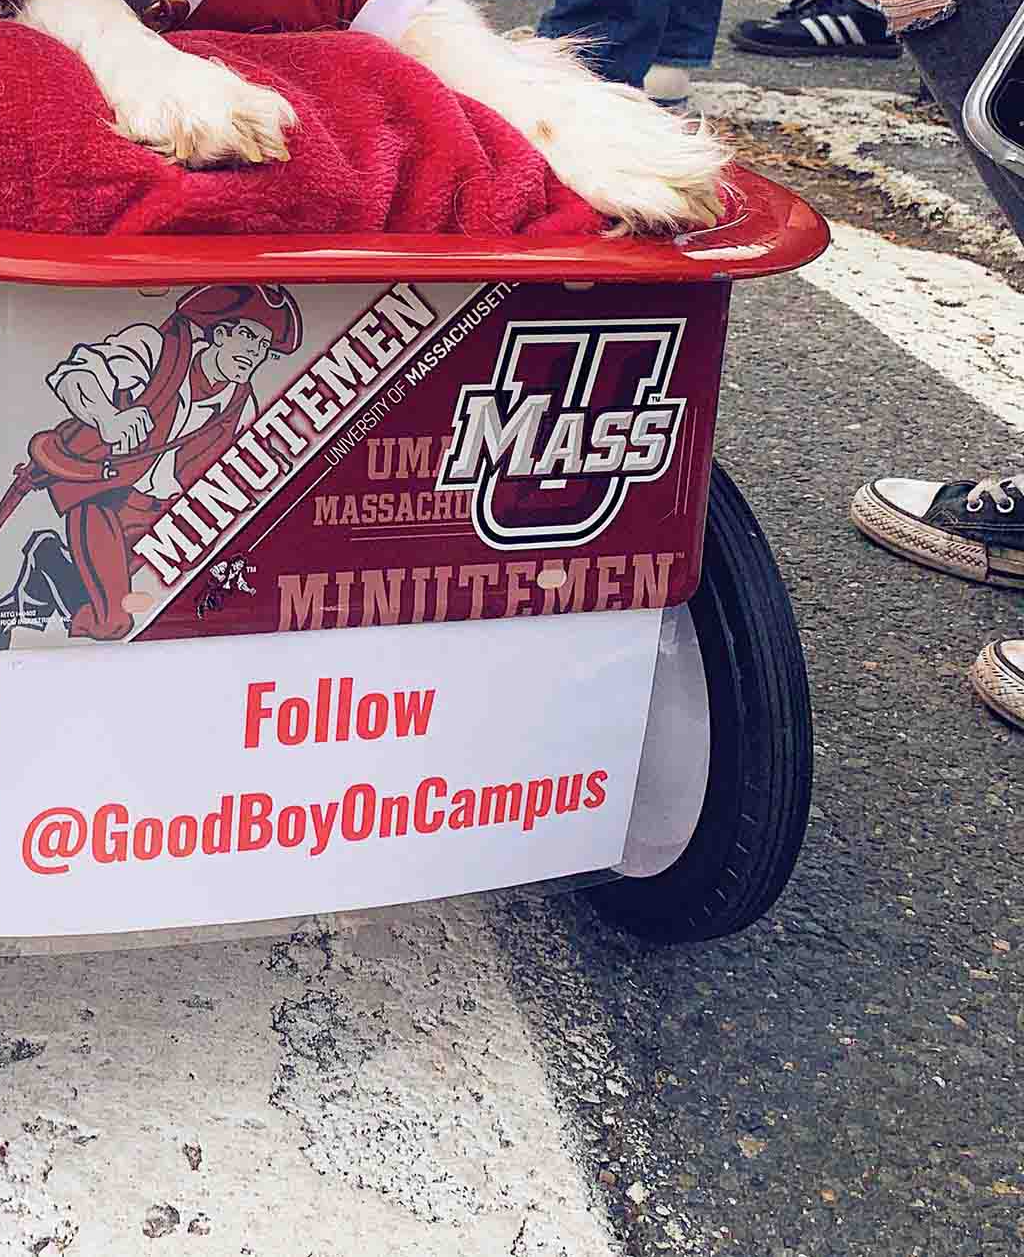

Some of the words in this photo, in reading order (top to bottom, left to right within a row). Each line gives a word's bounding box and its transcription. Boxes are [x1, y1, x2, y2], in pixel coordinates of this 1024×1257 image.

[133, 283, 436, 586] MINUTEMEN
[324, 397, 391, 467] UNIVERSITY
[388, 381, 407, 404] OF
[244, 678, 436, 748] Follow
[22, 766, 609, 874] @GoodBoyOnCampus
